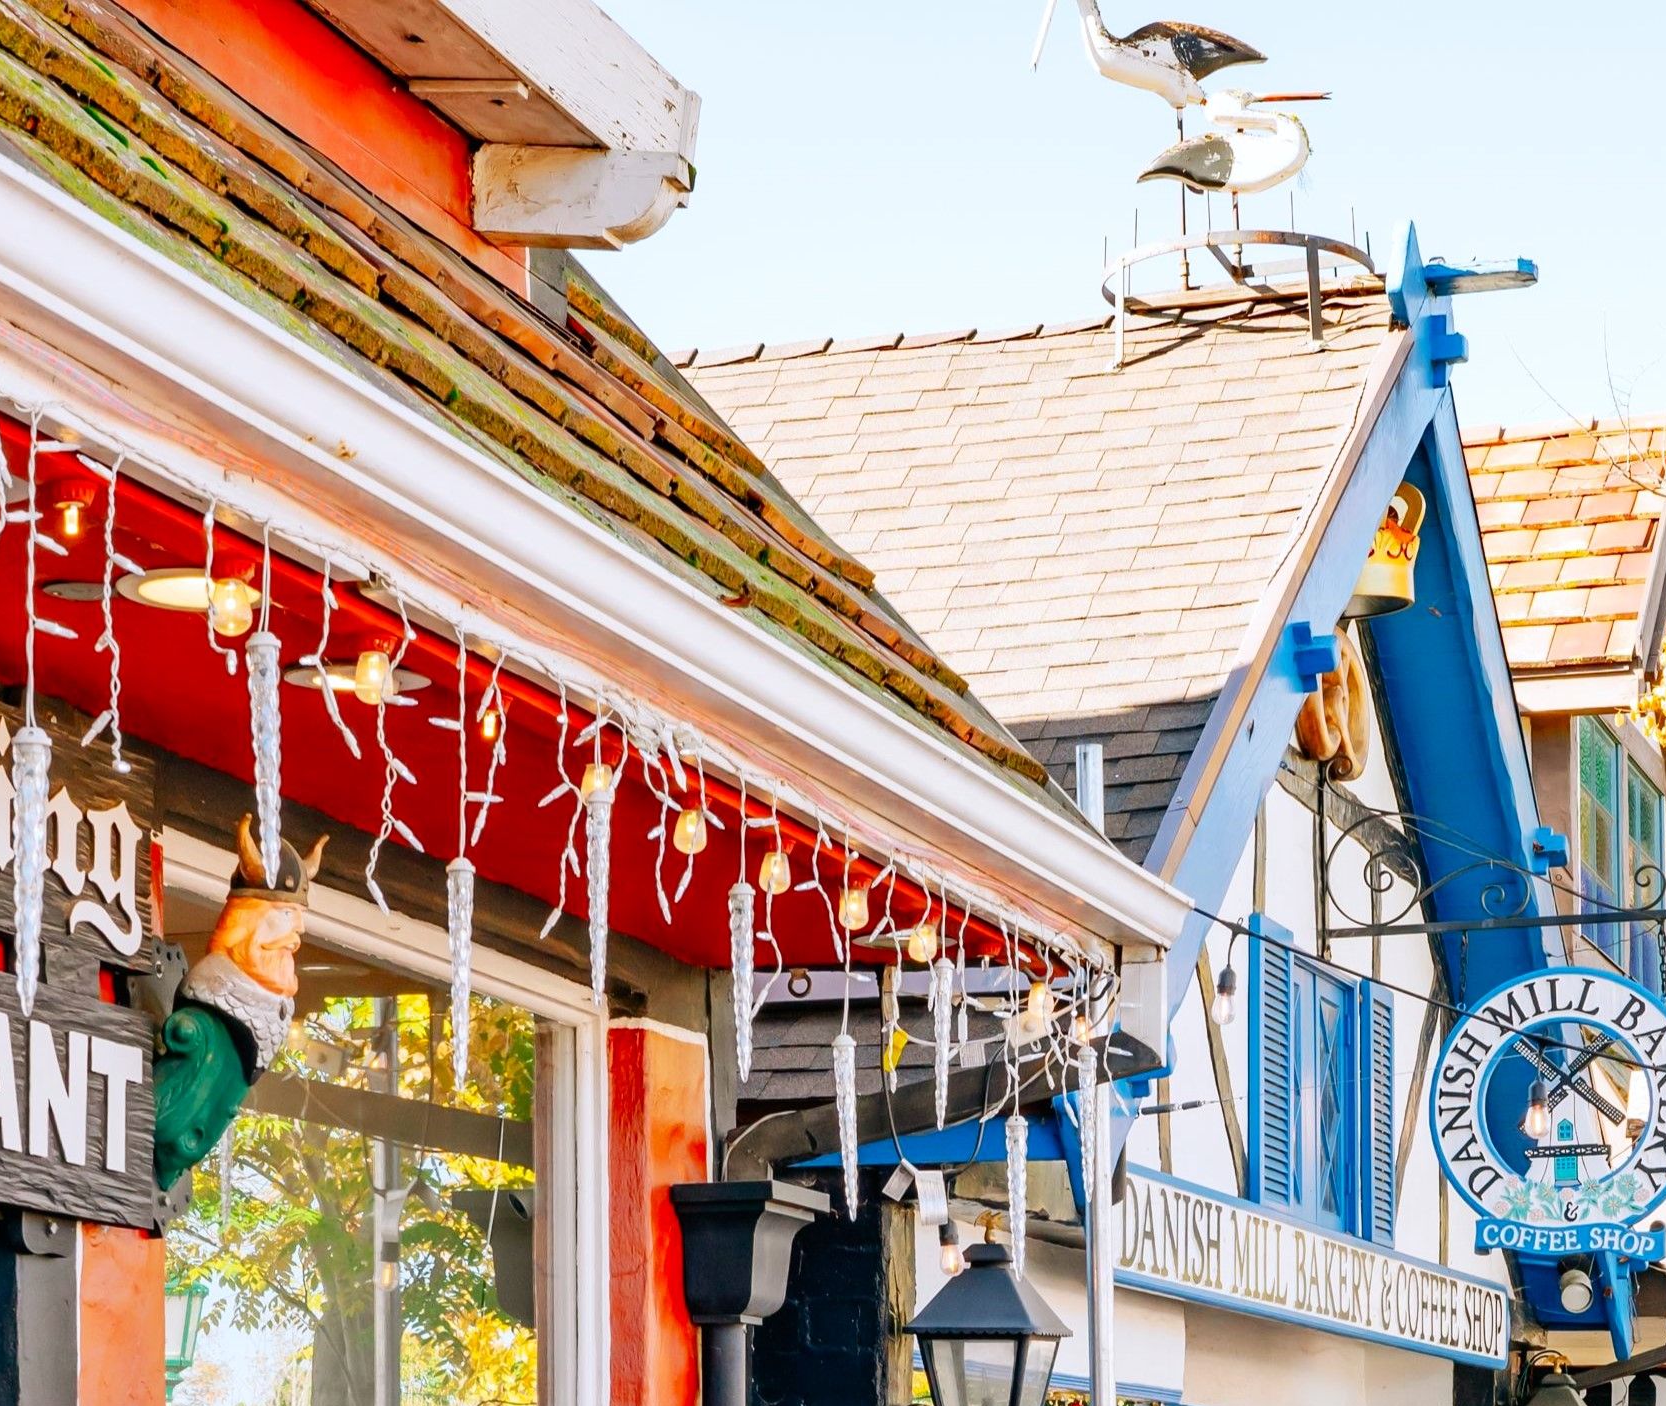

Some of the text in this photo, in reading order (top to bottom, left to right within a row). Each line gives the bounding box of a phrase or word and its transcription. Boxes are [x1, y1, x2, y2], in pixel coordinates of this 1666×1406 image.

[1438, 1029, 1503, 1200] DANISH
[1483, 978, 1600, 1037] MILL
[1482, 1223, 1656, 1257] COFFEE SHOP
[1563, 1201, 1580, 1223] &
[1118, 1177, 1503, 1356] DANISH MILL BAKERY & COFFEE SHOP
